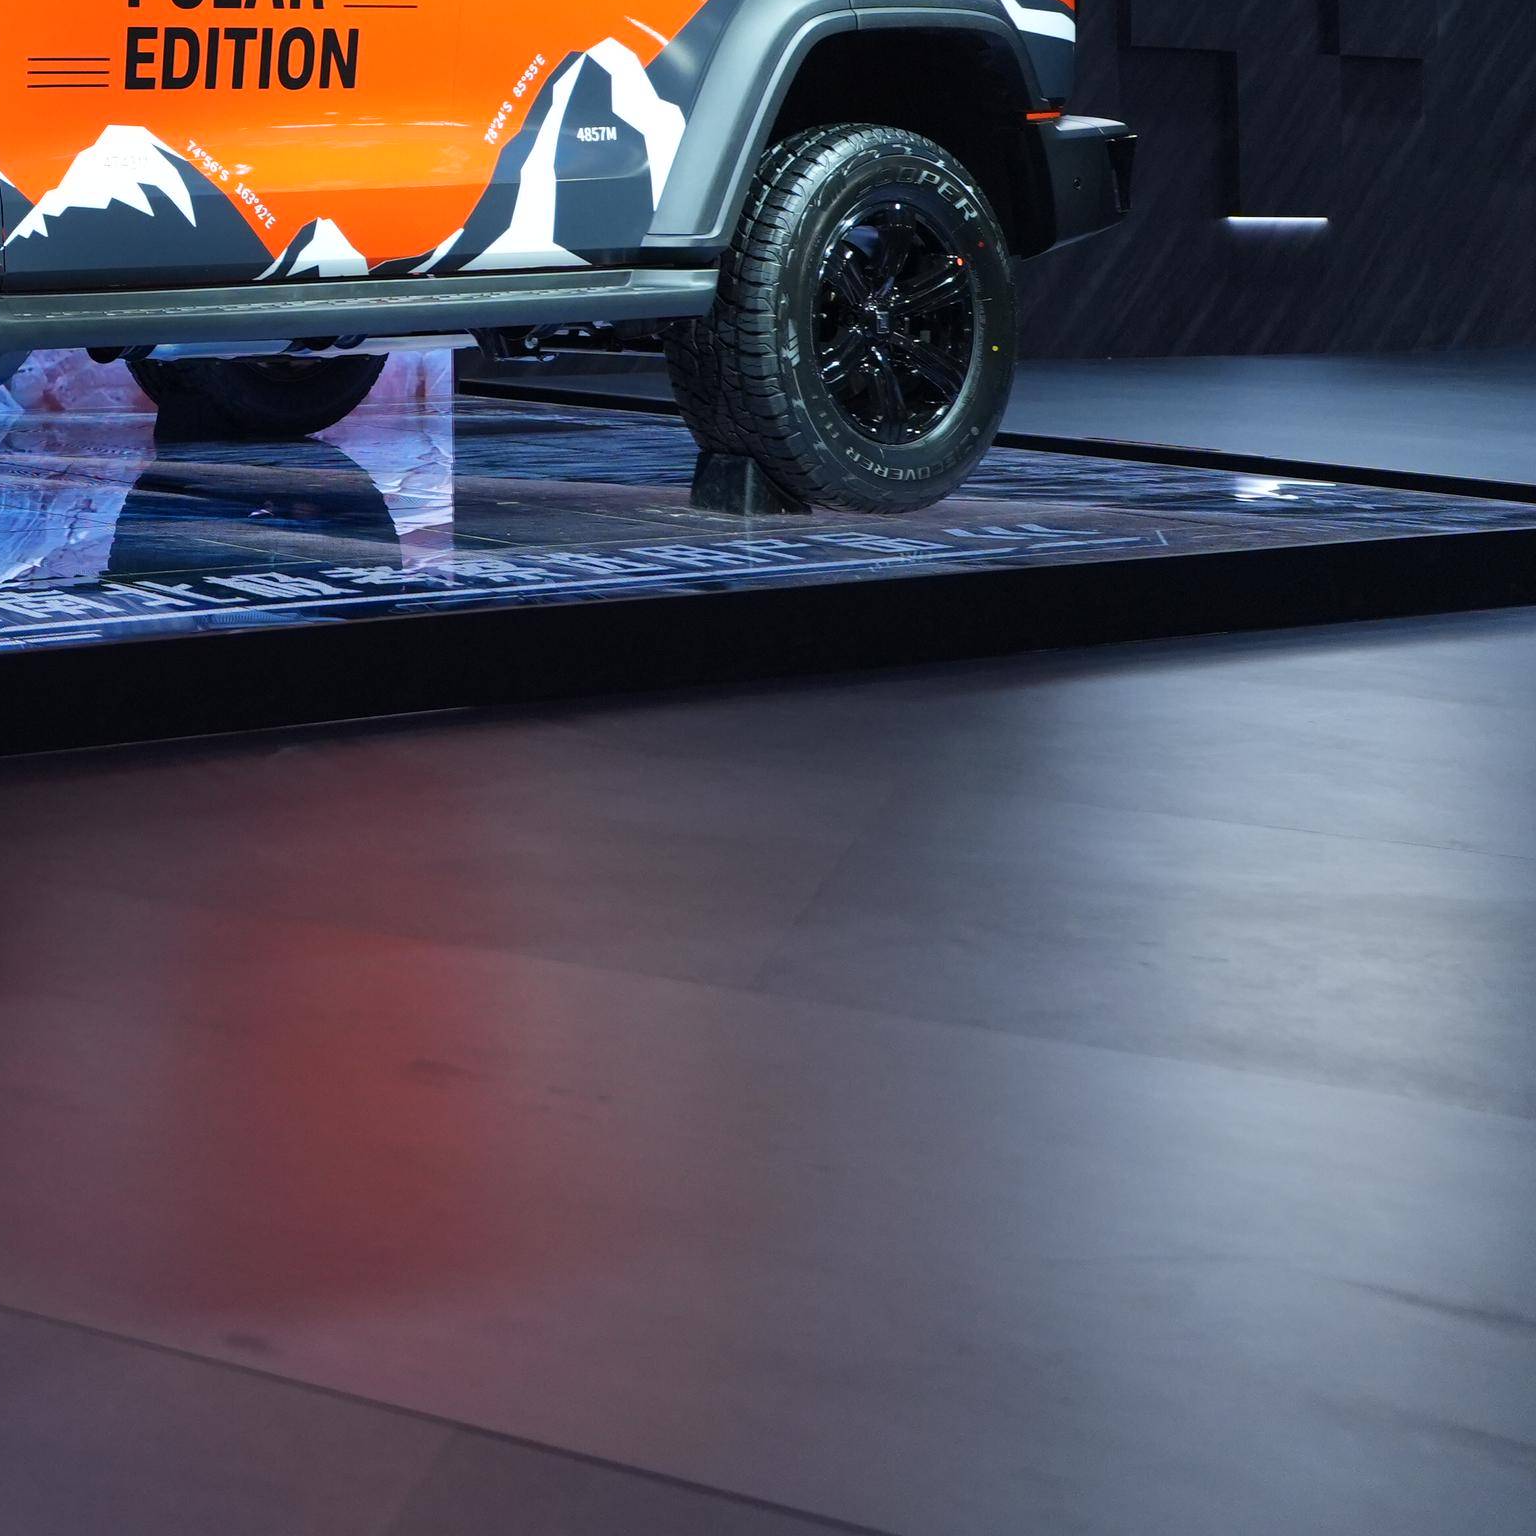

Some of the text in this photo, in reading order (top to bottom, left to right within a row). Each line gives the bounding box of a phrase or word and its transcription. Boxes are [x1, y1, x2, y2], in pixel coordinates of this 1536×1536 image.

[124, 26, 360, 90] EDITION
[484, 53, 546, 145] 78°24'S 85°55'E
[576, 126, 618, 142] 4857M
[187, 139, 276, 230] 74°56'S 163°42'E
